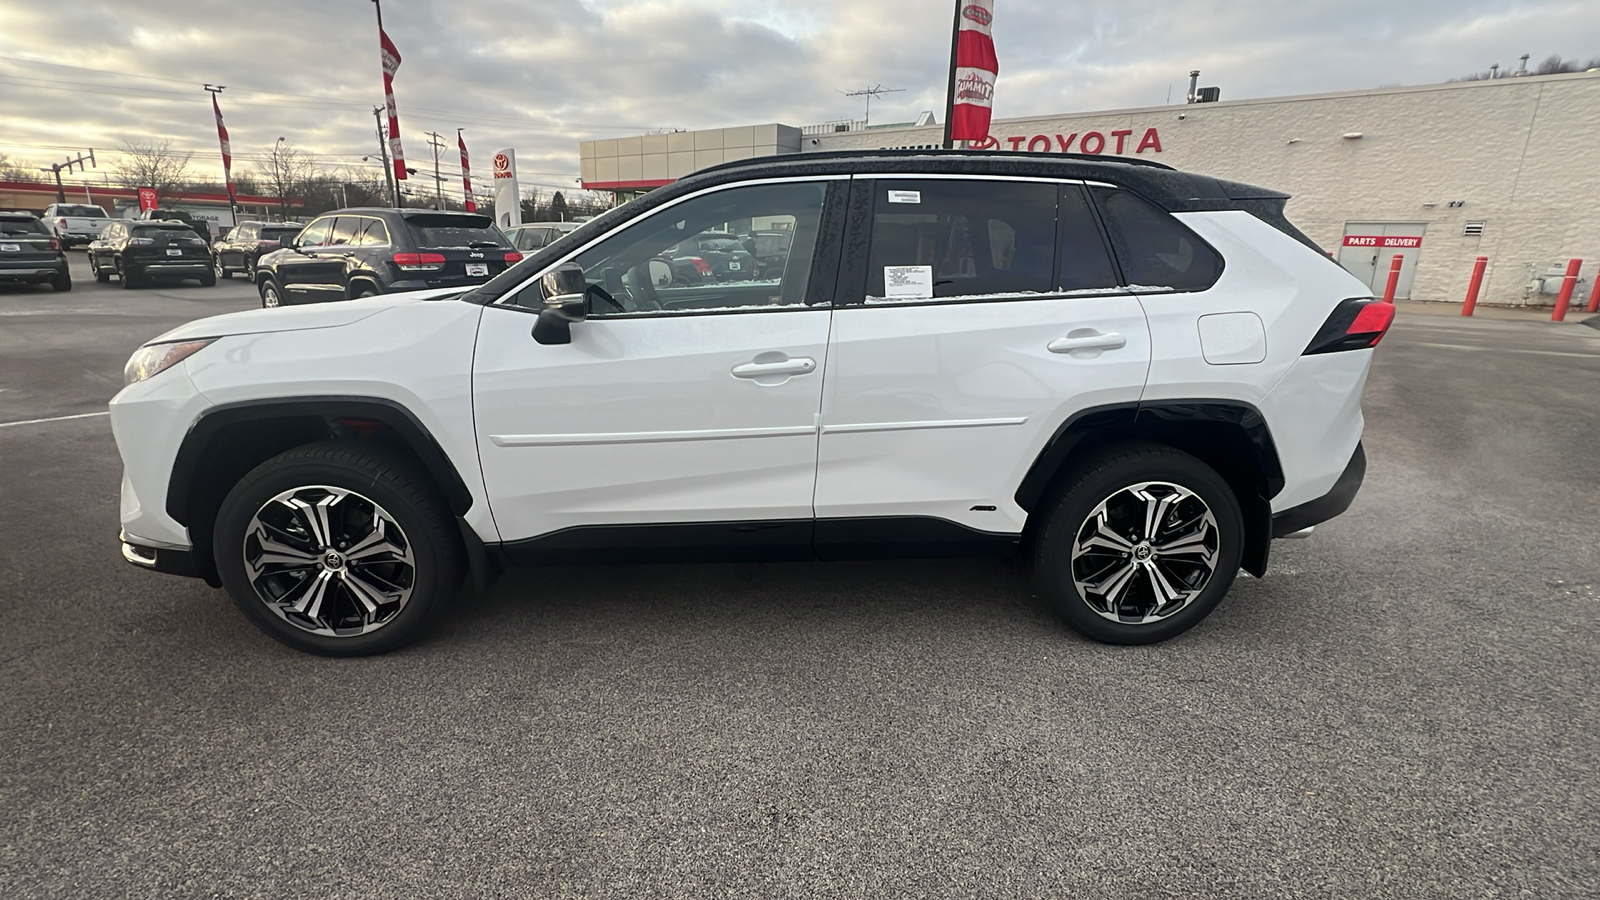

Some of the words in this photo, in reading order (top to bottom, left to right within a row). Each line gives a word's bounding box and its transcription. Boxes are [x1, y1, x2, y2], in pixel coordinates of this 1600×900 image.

[1007, 127, 1163, 155] TOYOTA
[1348, 237, 1376, 246] PARTS
[1384, 238, 1419, 247] DELIVERY
[469, 251, 485, 259] Jeep
